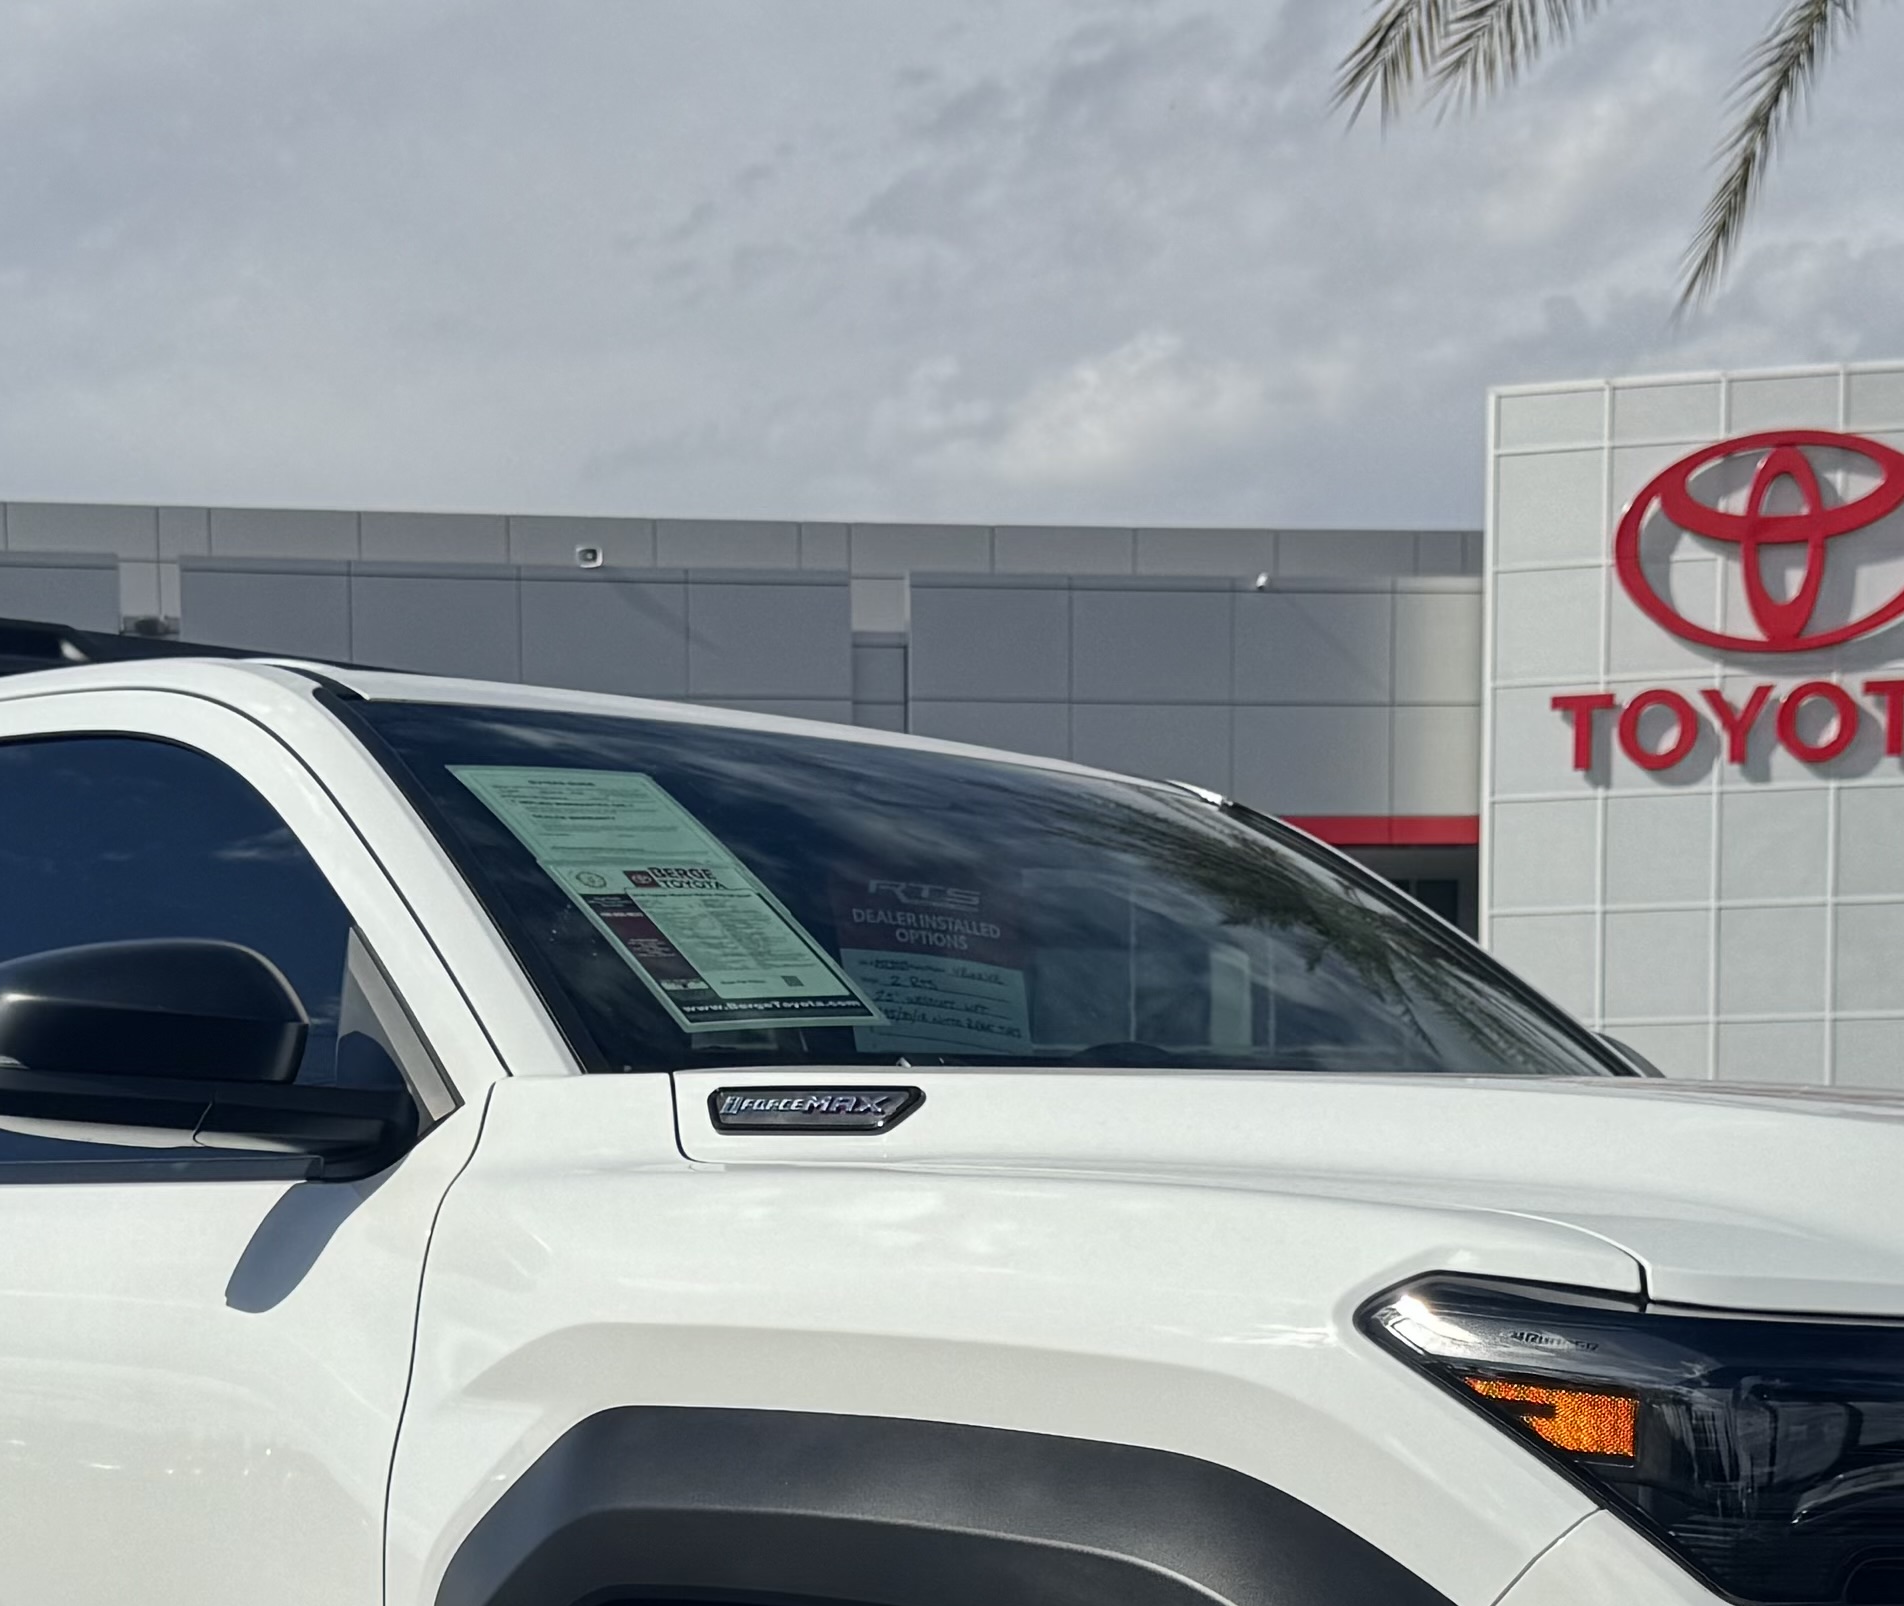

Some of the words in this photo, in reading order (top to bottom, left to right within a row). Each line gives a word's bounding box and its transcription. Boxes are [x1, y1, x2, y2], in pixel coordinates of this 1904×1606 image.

[647, 867, 717, 880] BERGE
[659, 879, 728, 890] TOYOTA
[852, 907, 917, 927] DEALER
[919, 914, 1001, 939] INSTALLED
[896, 928, 969, 950] OPTIONS
